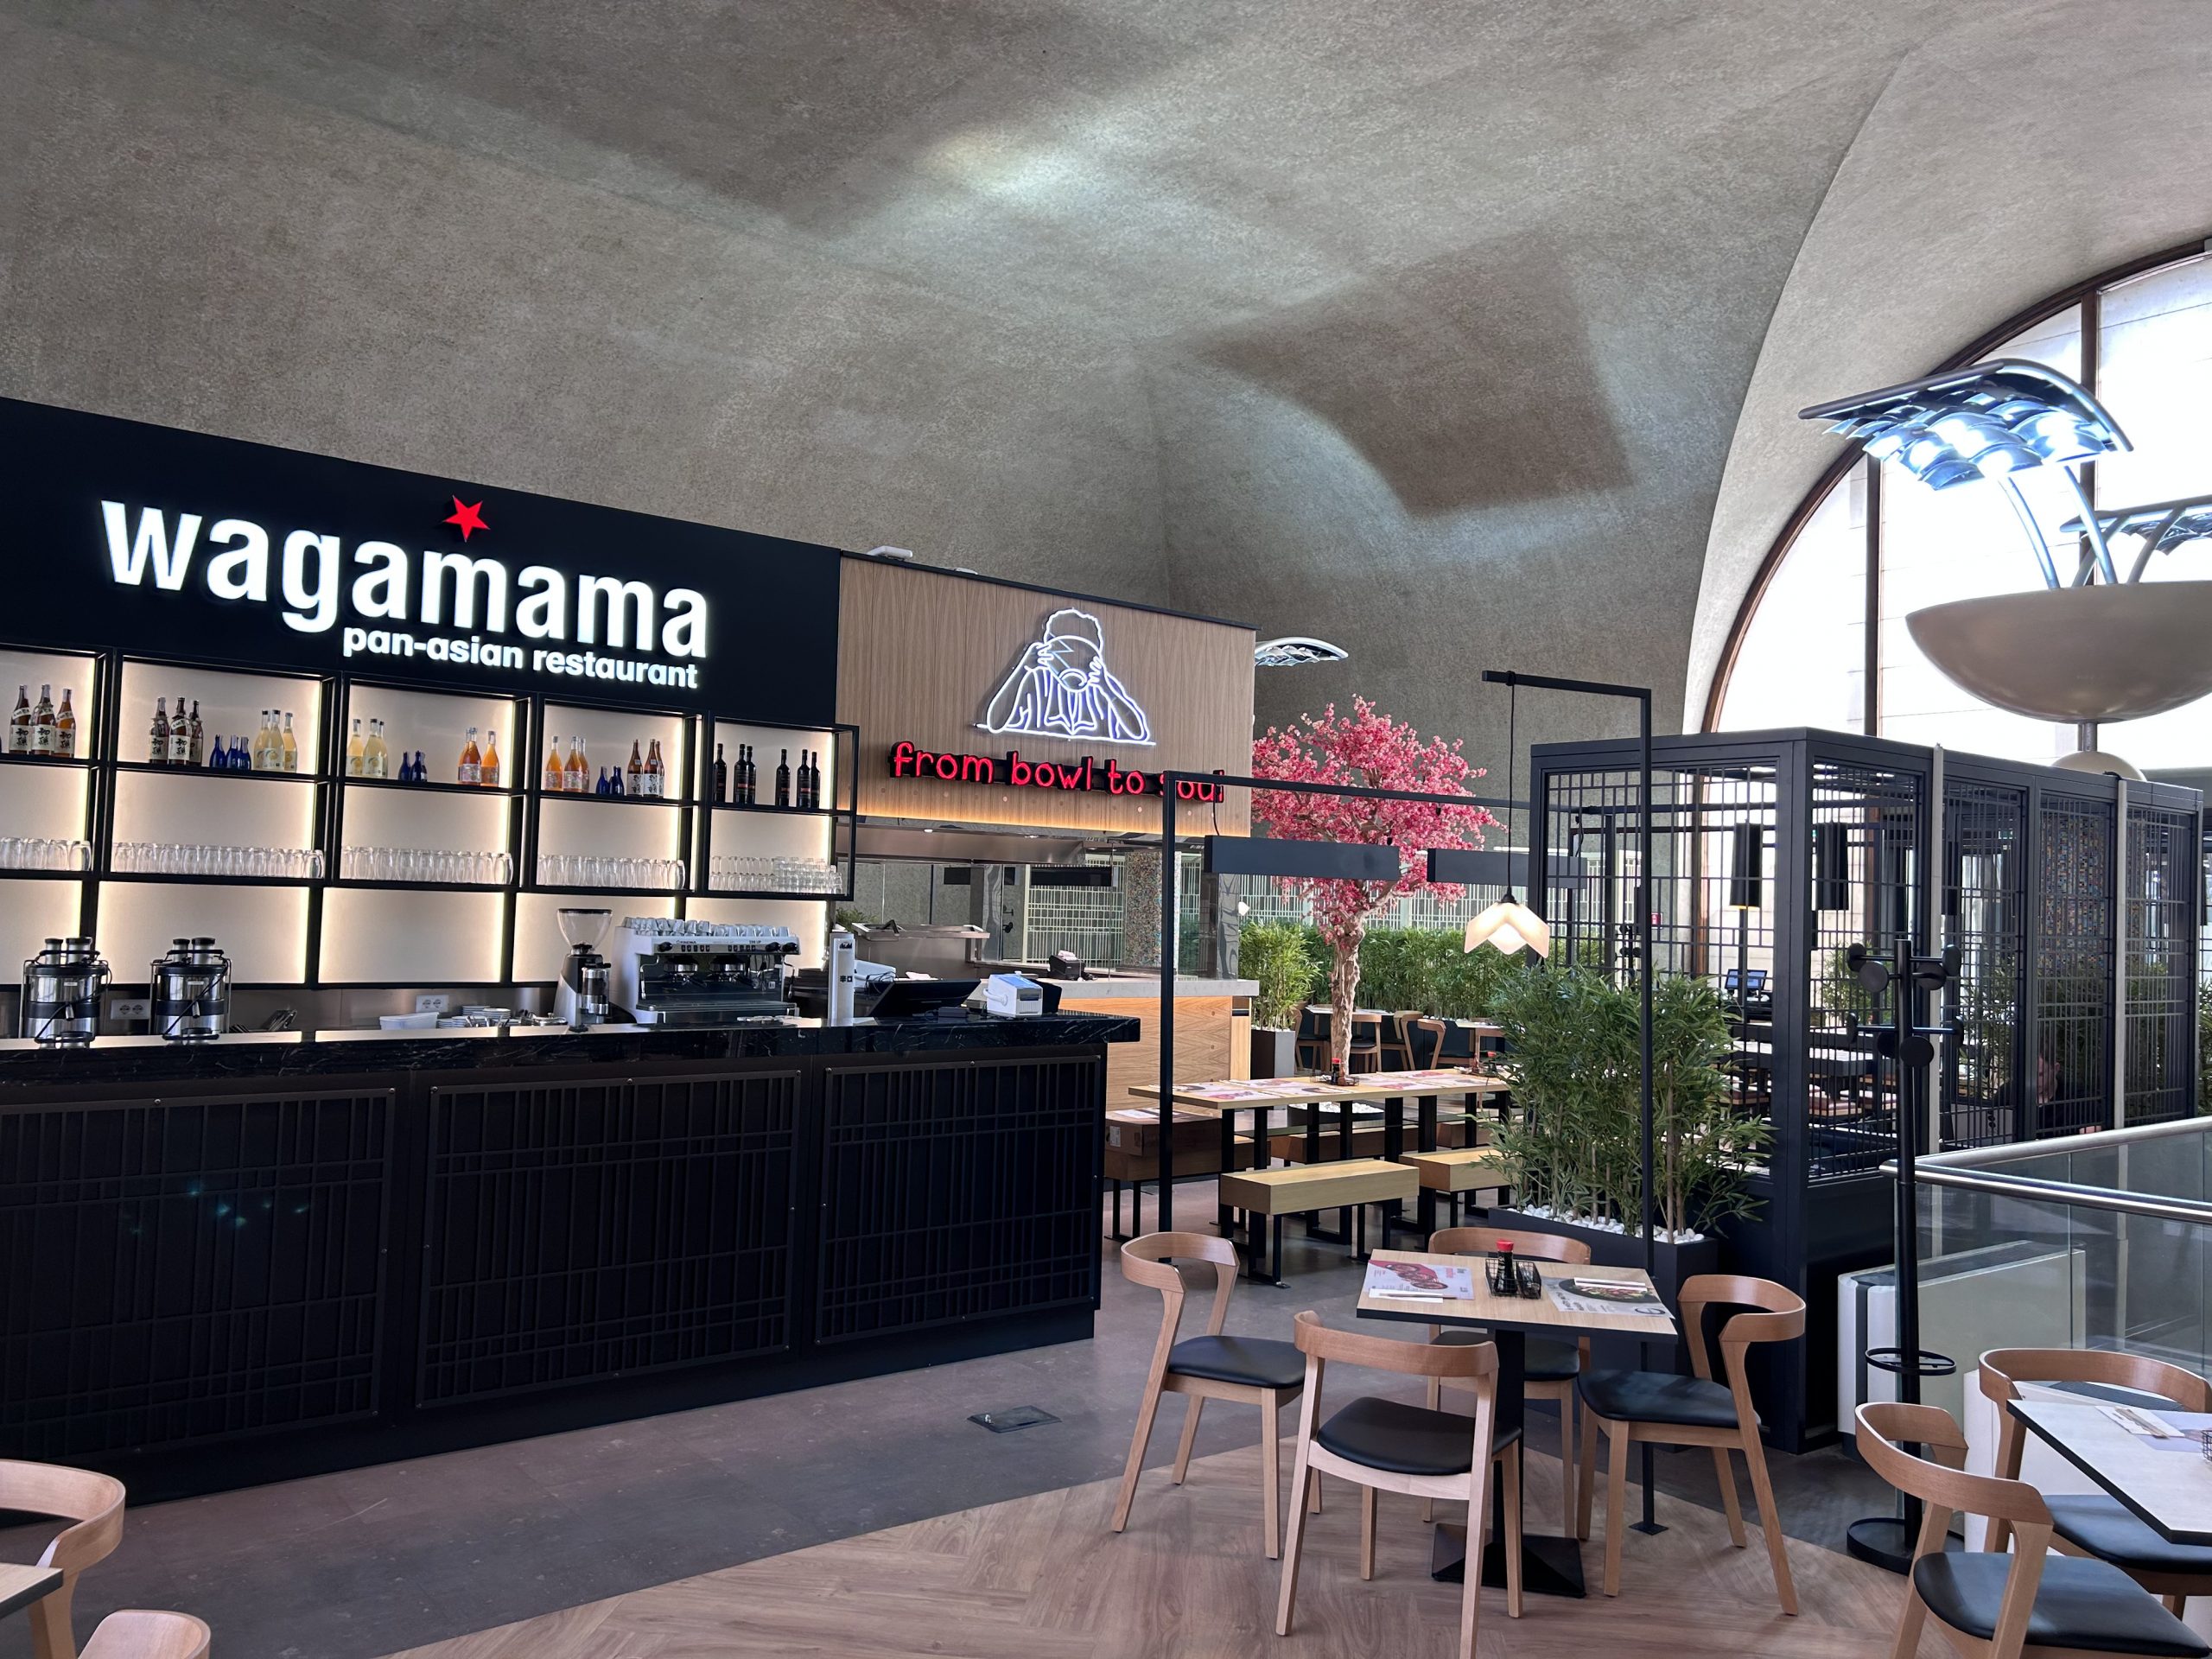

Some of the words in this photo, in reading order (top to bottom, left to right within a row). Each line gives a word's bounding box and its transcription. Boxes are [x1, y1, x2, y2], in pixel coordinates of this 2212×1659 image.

[100, 499, 708, 659] wagamama
[343, 626, 524, 670] pan-asian
[532, 650, 699, 689] restaurant
[893, 741, 994, 784] from
[1011, 750, 1093, 791] bowl
[1108, 759, 1145, 795] to
